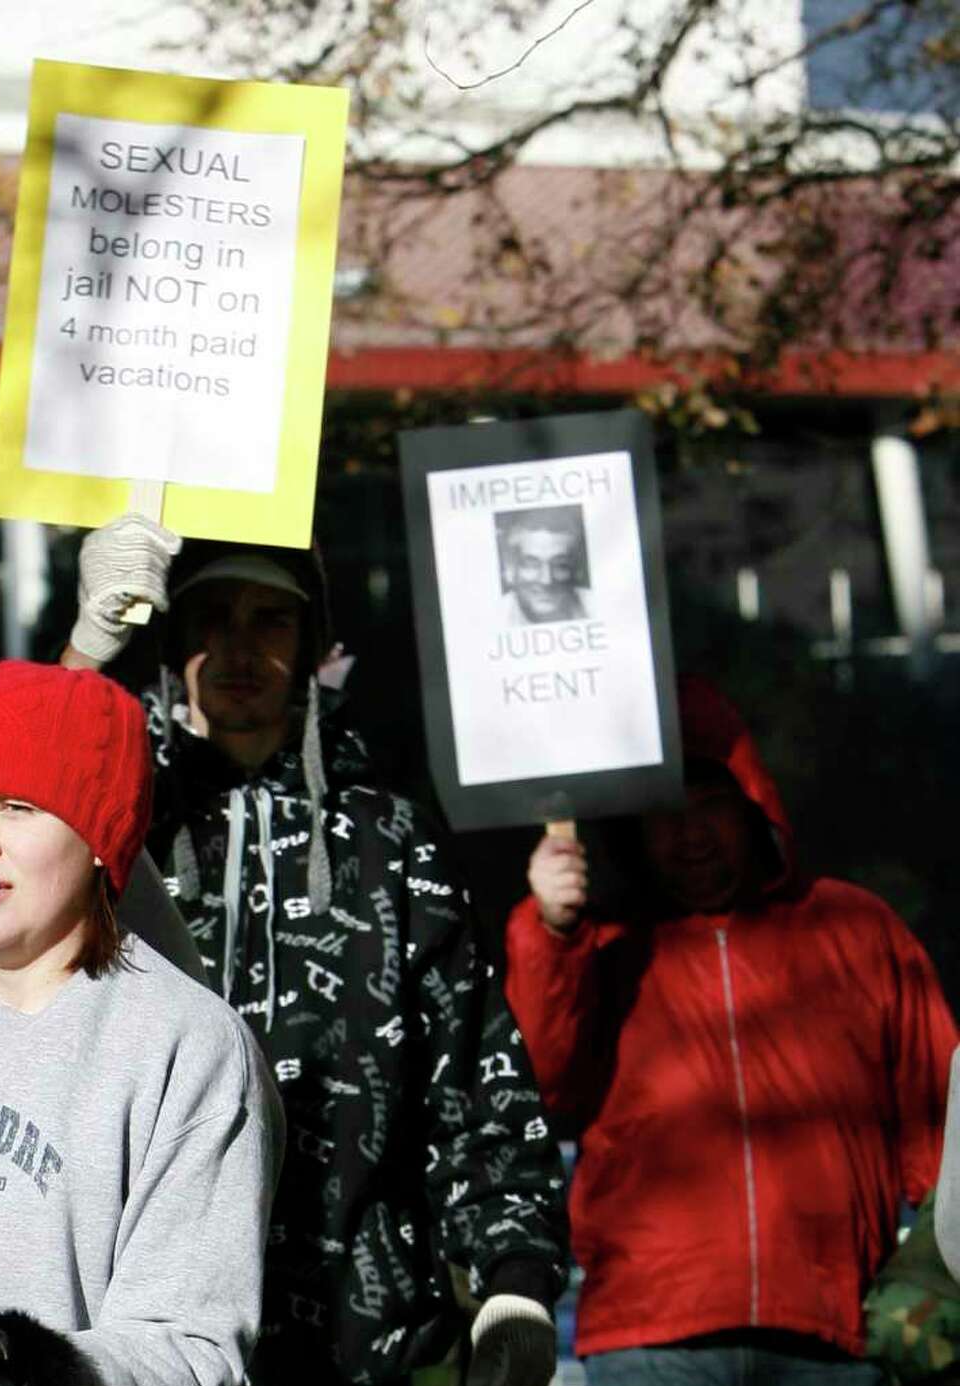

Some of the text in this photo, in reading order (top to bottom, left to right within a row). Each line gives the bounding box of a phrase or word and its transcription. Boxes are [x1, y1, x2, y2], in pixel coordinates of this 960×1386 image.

[100, 142, 250, 183] SEXUAL
[71, 185, 272, 227] MOLESTERS
[89, 228, 245, 271] belong in
[62, 268, 260, 315] jail NOT on
[60, 317, 257, 358] 4 month paid
[80, 362, 230, 397] vacations
[450, 470, 611, 511] IMPEACH
[488, 622, 609, 662] JUDGE
[503, 667, 604, 704] KENT
